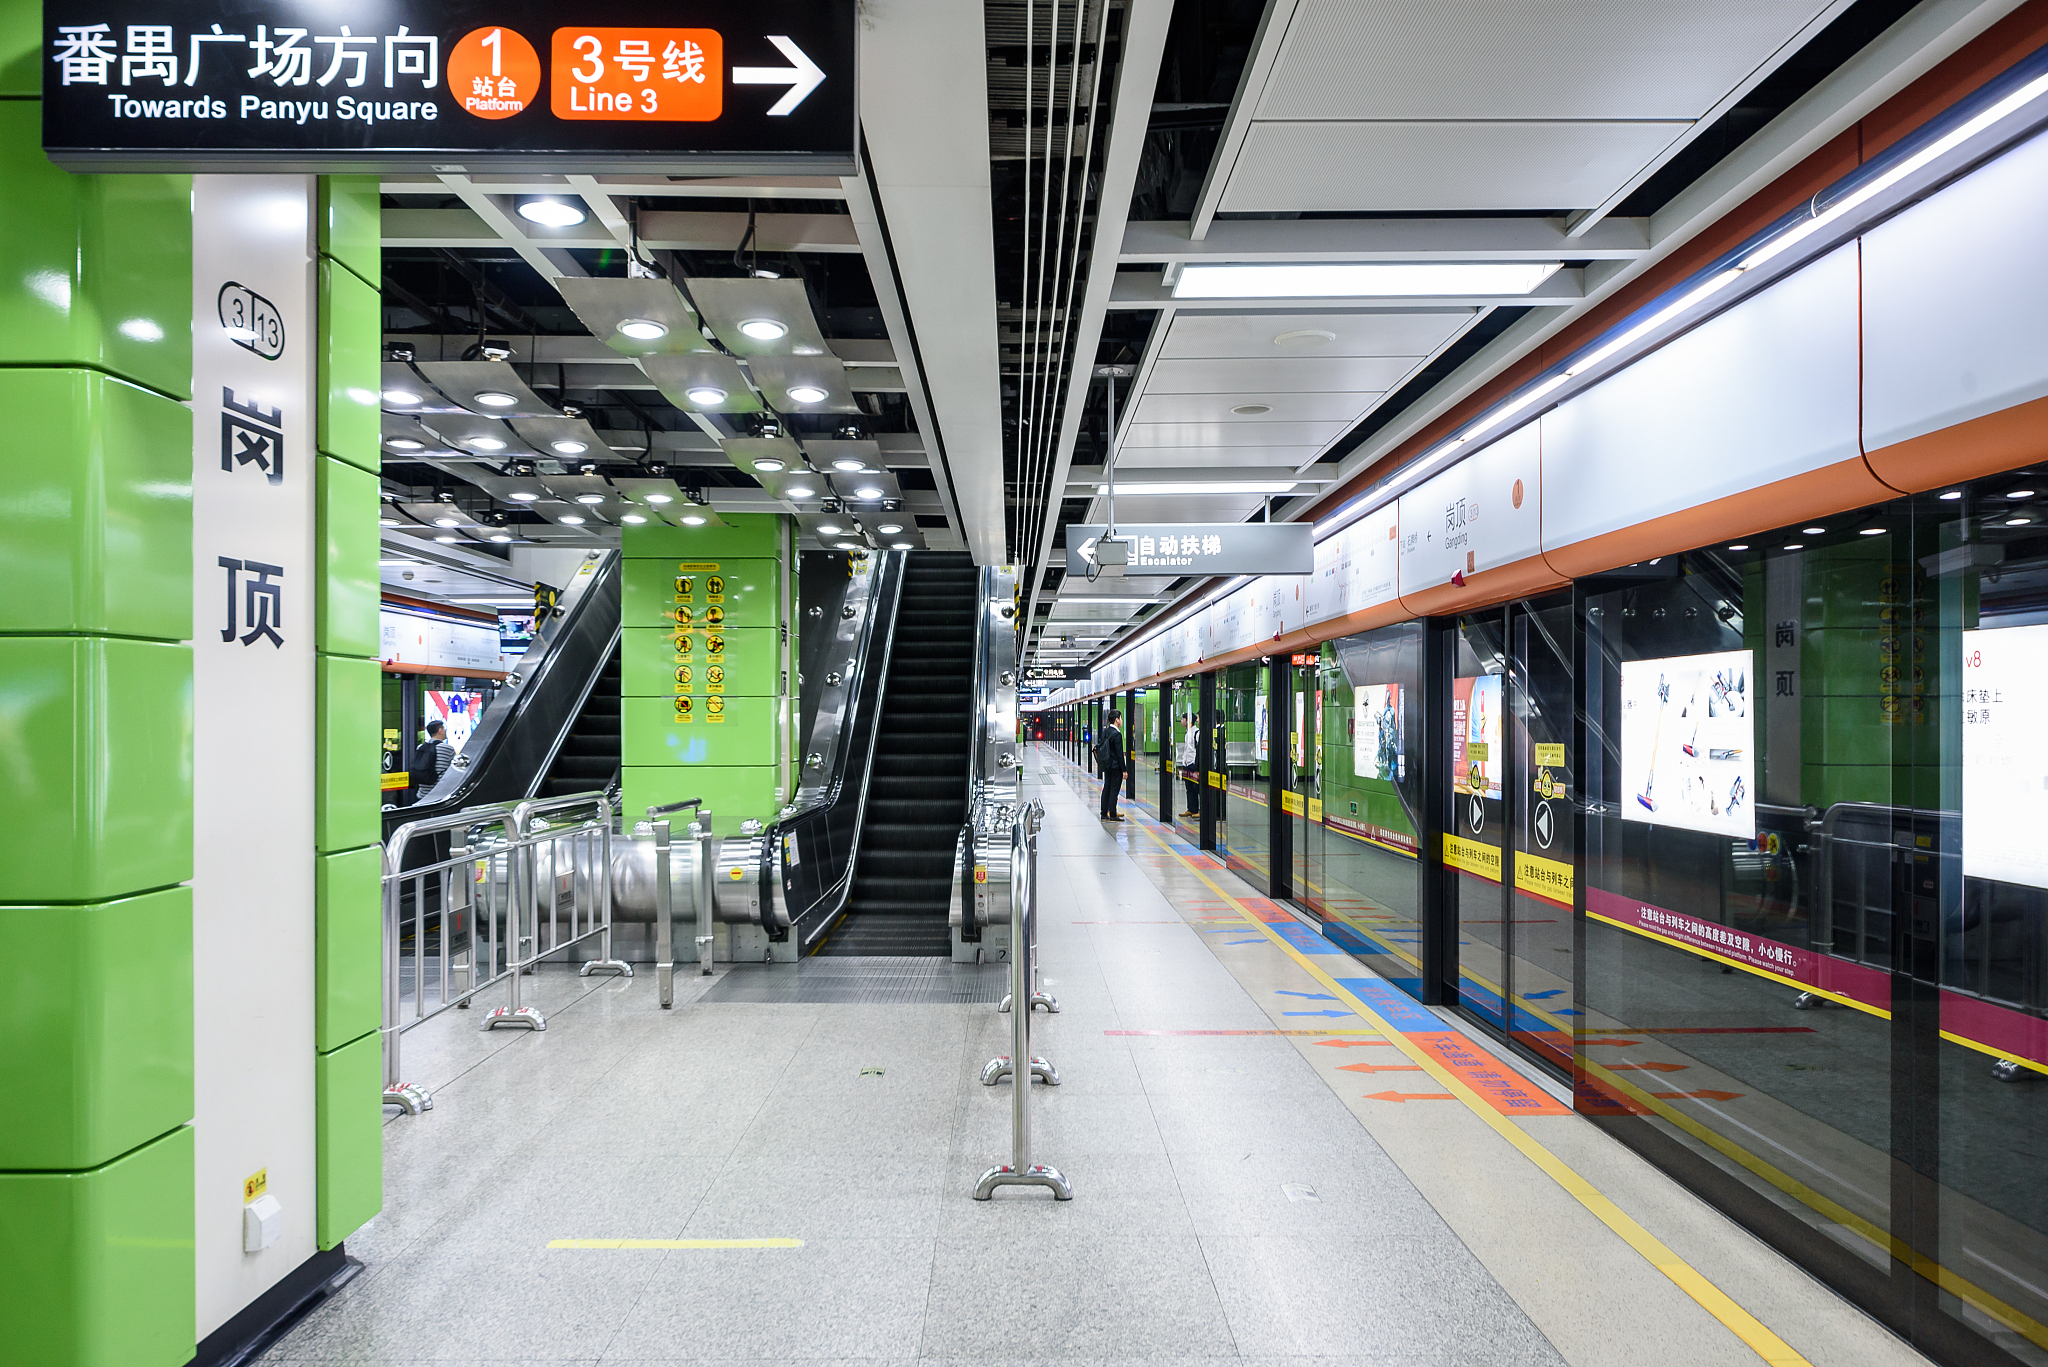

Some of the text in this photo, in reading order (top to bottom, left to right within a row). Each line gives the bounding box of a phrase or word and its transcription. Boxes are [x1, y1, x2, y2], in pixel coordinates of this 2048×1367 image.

[53, 23, 439, 89] 番禺广场方向
[481, 28, 502, 77] 1
[571, 35, 706, 84] 3号线
[472, 76, 517, 98] 站台
[570, 85, 658, 114] Line 3
[108, 94, 438, 125] Towards Panyu Square
[465, 96, 523, 112] Platform
[256, 313, 279, 348] 13
[1445, 497, 1466, 533] 岗顶
[1140, 535, 1222, 556] 自动扶梯
[1140, 556, 1193, 566] Escalator
[1965, 650, 1982, 668] v8
[1962, 688, 2003, 704] 床垫上
[1962, 709, 1990, 725] 敏原
